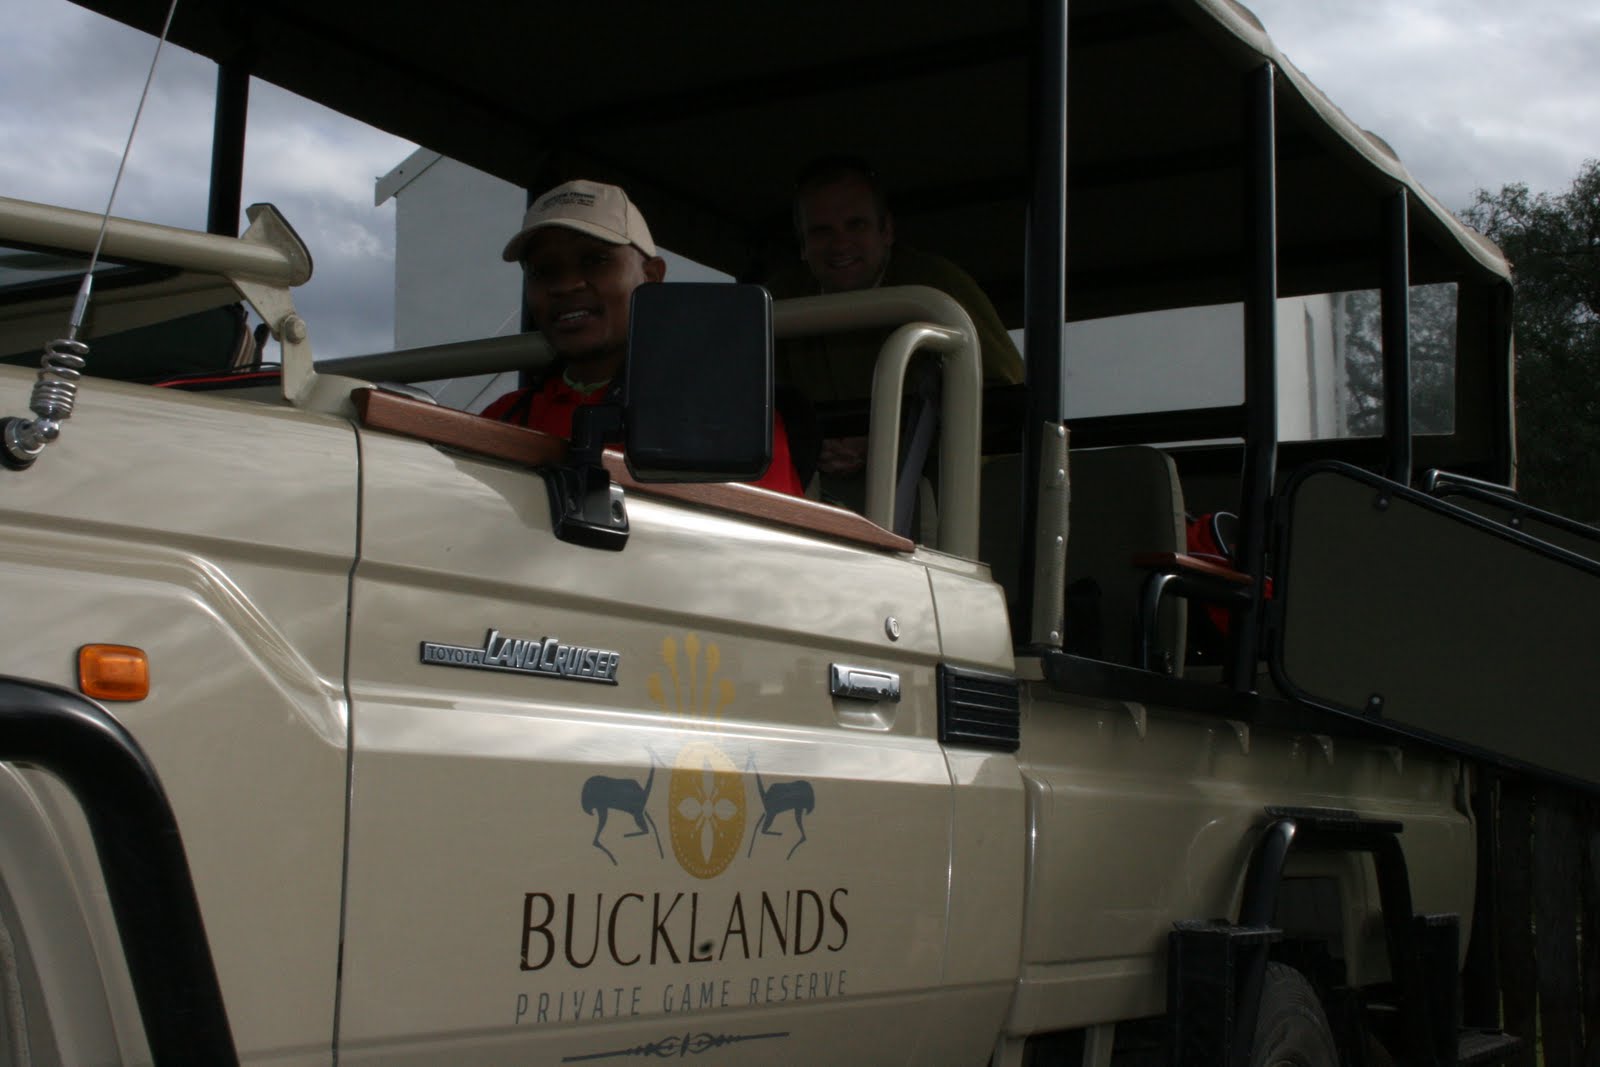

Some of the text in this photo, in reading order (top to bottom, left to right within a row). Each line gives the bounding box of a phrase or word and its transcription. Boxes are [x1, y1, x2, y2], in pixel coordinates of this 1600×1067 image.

[428, 645, 481, 665] TOYOTA
[519, 887, 849, 972] BUCKLANDS
[515, 969, 848, 1025] PRIVATE GAME RESERVE
